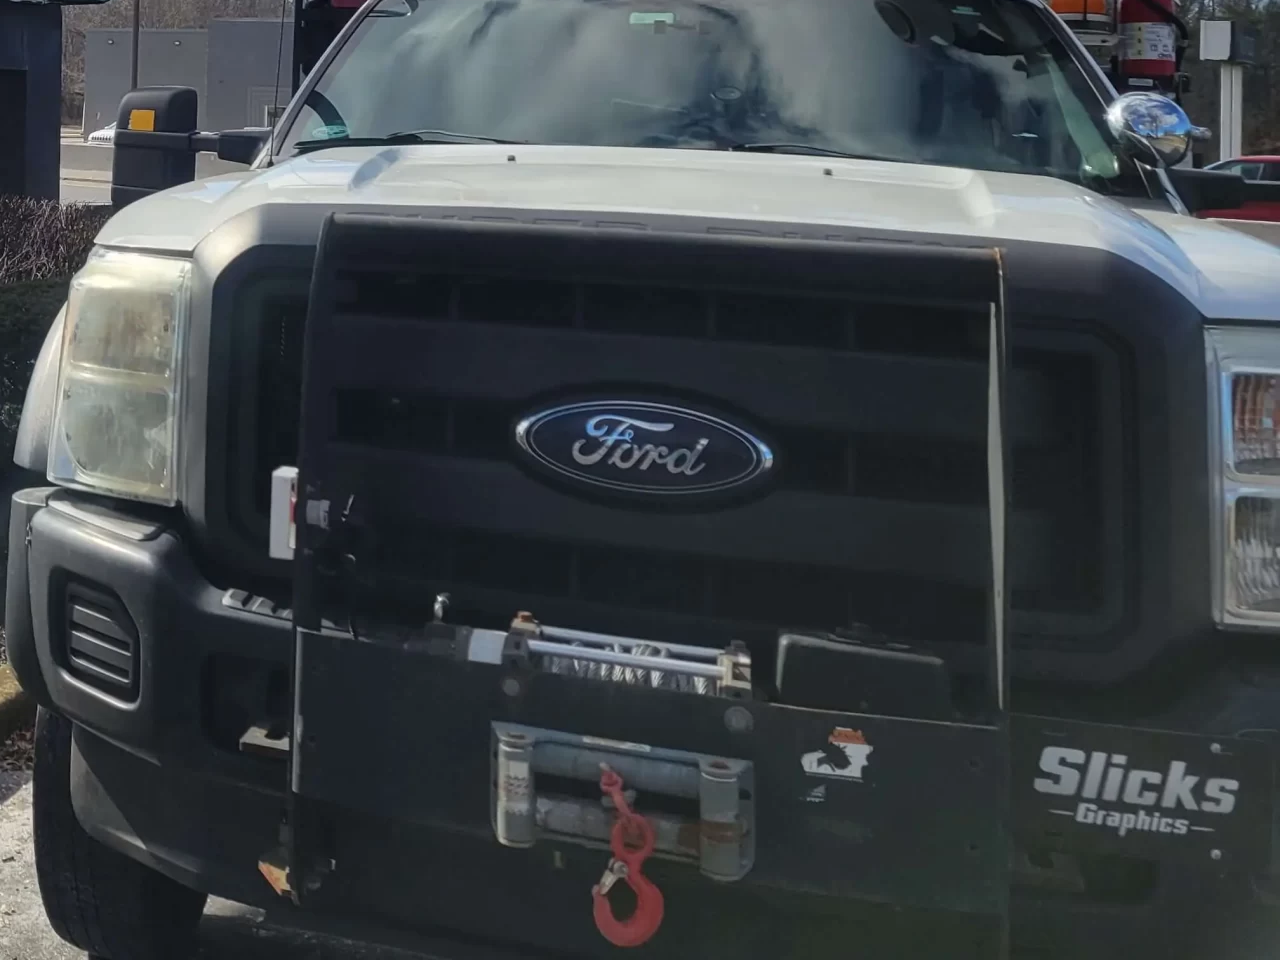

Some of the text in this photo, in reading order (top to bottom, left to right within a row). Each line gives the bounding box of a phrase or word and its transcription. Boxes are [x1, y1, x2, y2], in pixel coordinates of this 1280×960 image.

[571, 413, 710, 476] Ford
[1032, 745, 1240, 815] Slicks
[1074, 801, 1191, 838] Graphics
